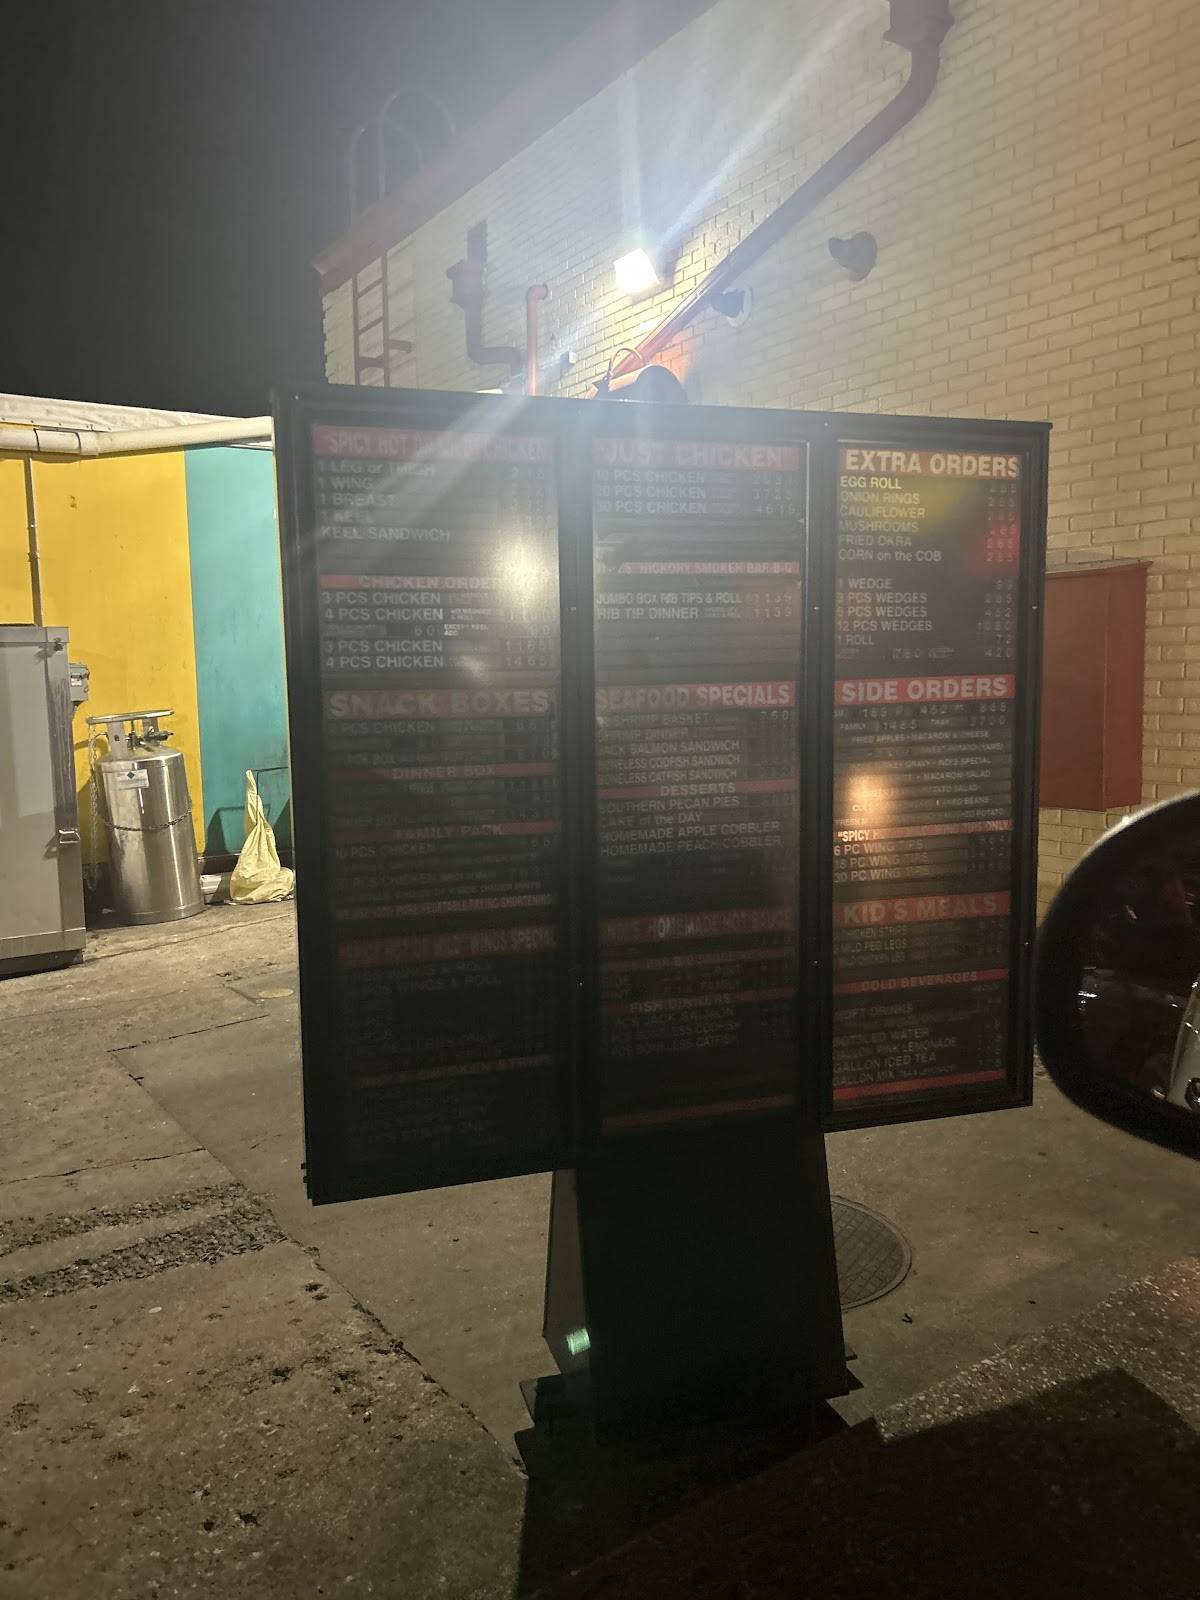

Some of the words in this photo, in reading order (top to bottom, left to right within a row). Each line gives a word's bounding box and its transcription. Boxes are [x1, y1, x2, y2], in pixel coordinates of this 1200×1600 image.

[608, 442, 666, 464] JUST
[675, 445, 782, 467] CHICKEN
[845, 449, 922, 473] EXTRA
[929, 452, 1020, 479] ORDERS
[614, 470, 641, 483] PCS
[645, 471, 705, 483] CHICKEN
[840, 475, 867, 489] EGG
[870, 477, 903, 490] ROLL
[615, 486, 642, 498] PCS
[646, 486, 706, 499] CHICKEN
[840, 490, 880, 504] ONION
[882, 492, 921, 506] RINGS
[615, 502, 643, 514] PCS
[647, 502, 707, 514] CHICKEN
[840, 505, 927, 520] CAULIFLOWER
[321, 526, 363, 540] KEEL
[367, 528, 451, 542] SANDWICH
[840, 520, 920, 534] MUSHROOMS
[839, 535, 875, 548] FRIED
[878, 536, 913, 548] OKRA
[839, 549, 874, 562] CORN
[877, 551, 892, 562] on
[894, 549, 913, 562] the
[915, 549, 942, 563] COB
[359, 576, 445, 590] CHICKEN
[848, 577, 893, 590] WEDGE
[335, 592, 368, 605] PCS
[373, 592, 441, 605] CHICKEN
[681, 593, 703, 604] TIPS
[716, 592, 743, 604] ROLL
[848, 592, 872, 604] PCS
[875, 591, 928, 604] WEDGES
[339, 608, 371, 621] PCS
[375, 608, 445, 621] CHICKEN
[597, 608, 621, 620] RIB
[648, 607, 699, 620] DINNER
[847, 606, 872, 618] PCS
[875, 606, 928, 618] WEDGES
[853, 620, 877, 632] PCS
[880, 620, 933, 632] WEDGES
[337, 640, 369, 653] PCS
[374, 640, 444, 653] CHICKEN
[845, 635, 874, 646] ROLL
[340, 656, 371, 669] PCS
[375, 656, 444, 669] CHICKEN
[695, 683, 791, 707] SPECIALS
[841, 681, 899, 702] SIDE
[906, 677, 1008, 701] ORDERS
[328, 691, 434, 717] SNACK
[450, 690, 549, 714] BOXES
[679, 739, 741, 754] SANDWICH
[660, 782, 737, 797] DESSERTS
[669, 797, 711, 811] PECAN
[712, 795, 741, 809] PIES
[677, 811, 704, 825] DAY
[600, 827, 674, 844] HOMEMADE
[677, 824, 718, 838] APPLE
[720, 820, 782, 836] COBBLER
[600, 841, 674, 858] HOMEMADE
[834, 844, 841, 856] 6
[844, 843, 861, 855] PC
[864, 840, 896, 853] WING
[849, 856, 866, 868] PC
[869, 853, 899, 867] WING
[833, 871, 848, 883] 30
[850, 869, 867, 882] PC
[871, 867, 901, 881] WING
[916, 895, 997, 920] MEALS
[901, 970, 978, 988] BEVERAGES
[833, 1058, 880, 1074] GALLON
[915, 1051, 937, 1064] TEA
